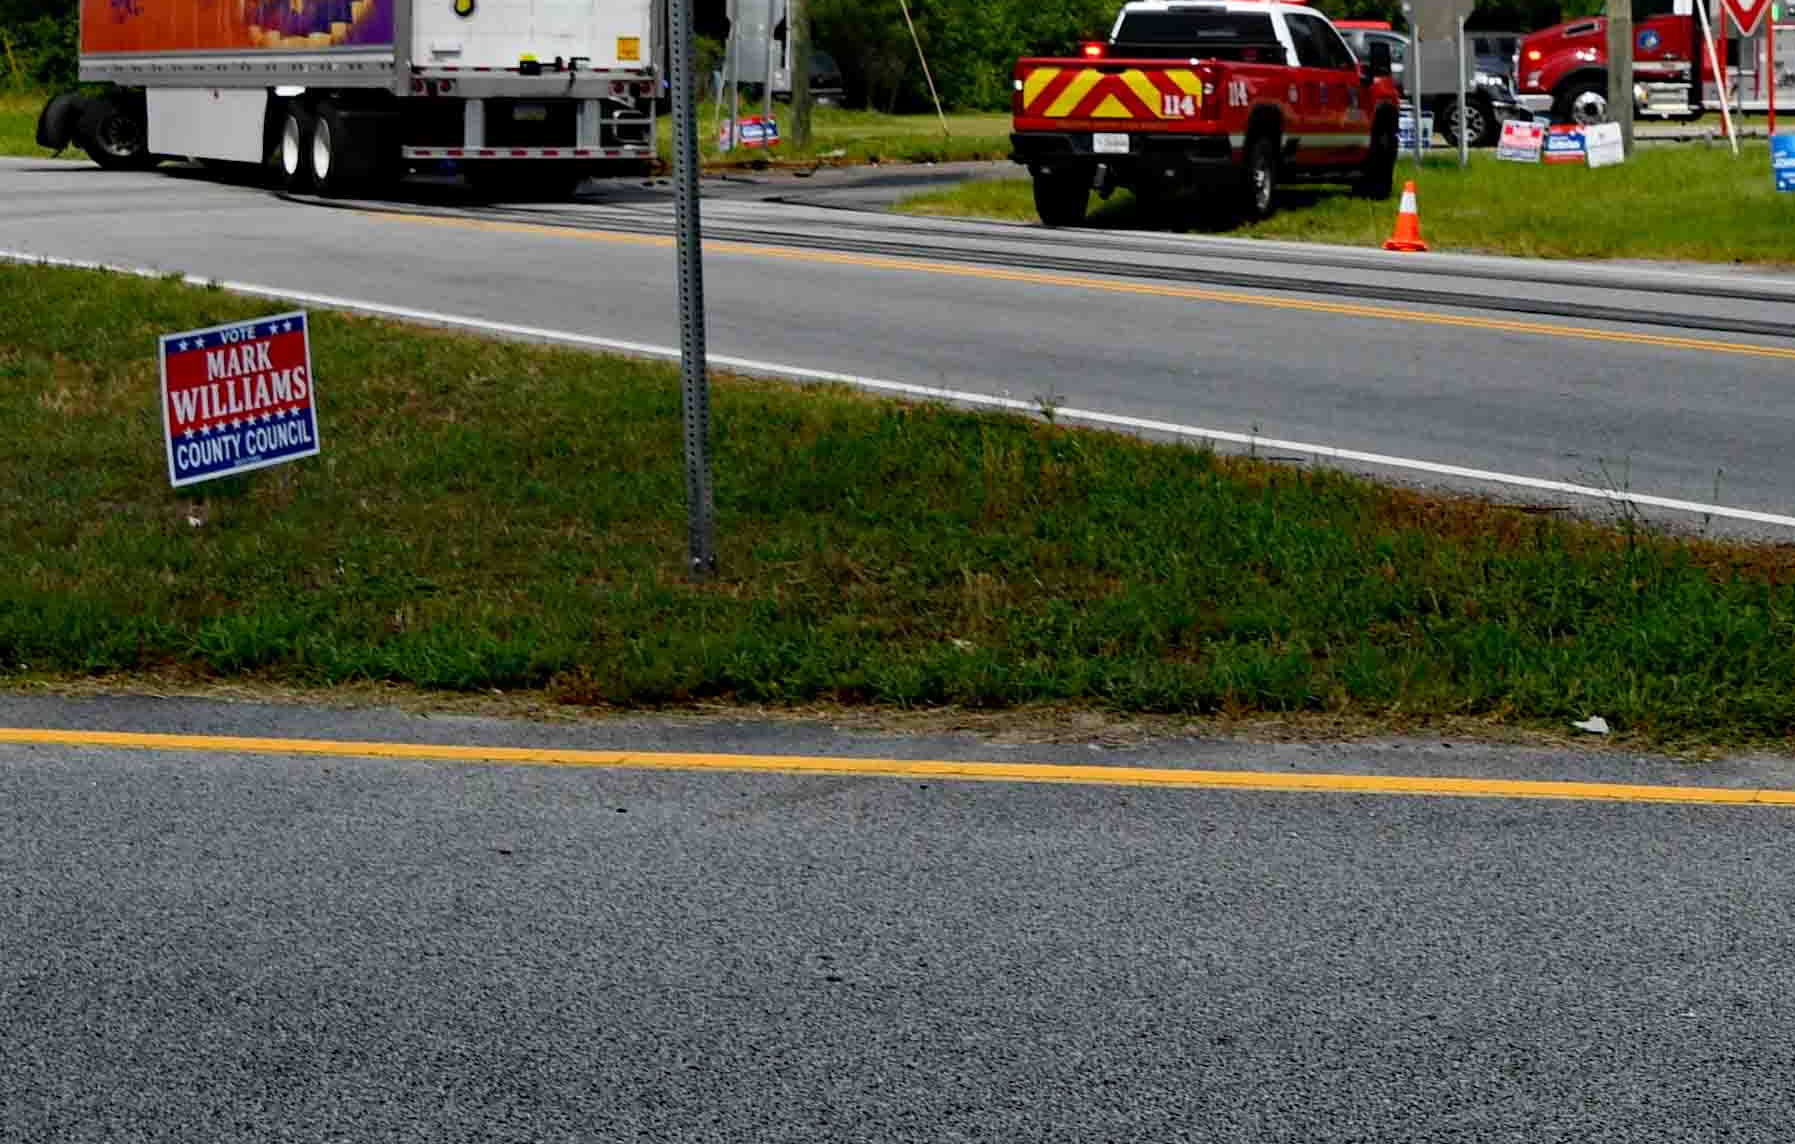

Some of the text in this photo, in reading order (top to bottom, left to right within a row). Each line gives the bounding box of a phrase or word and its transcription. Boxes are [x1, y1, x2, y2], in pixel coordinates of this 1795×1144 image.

[1164, 94, 1195, 116] 114
[220, 327, 257, 345] VOTE
[206, 341, 273, 382] MARK
[170, 365, 307, 425] WILLIAMS
[176, 419, 312, 471] COUNTY COUNCIL
